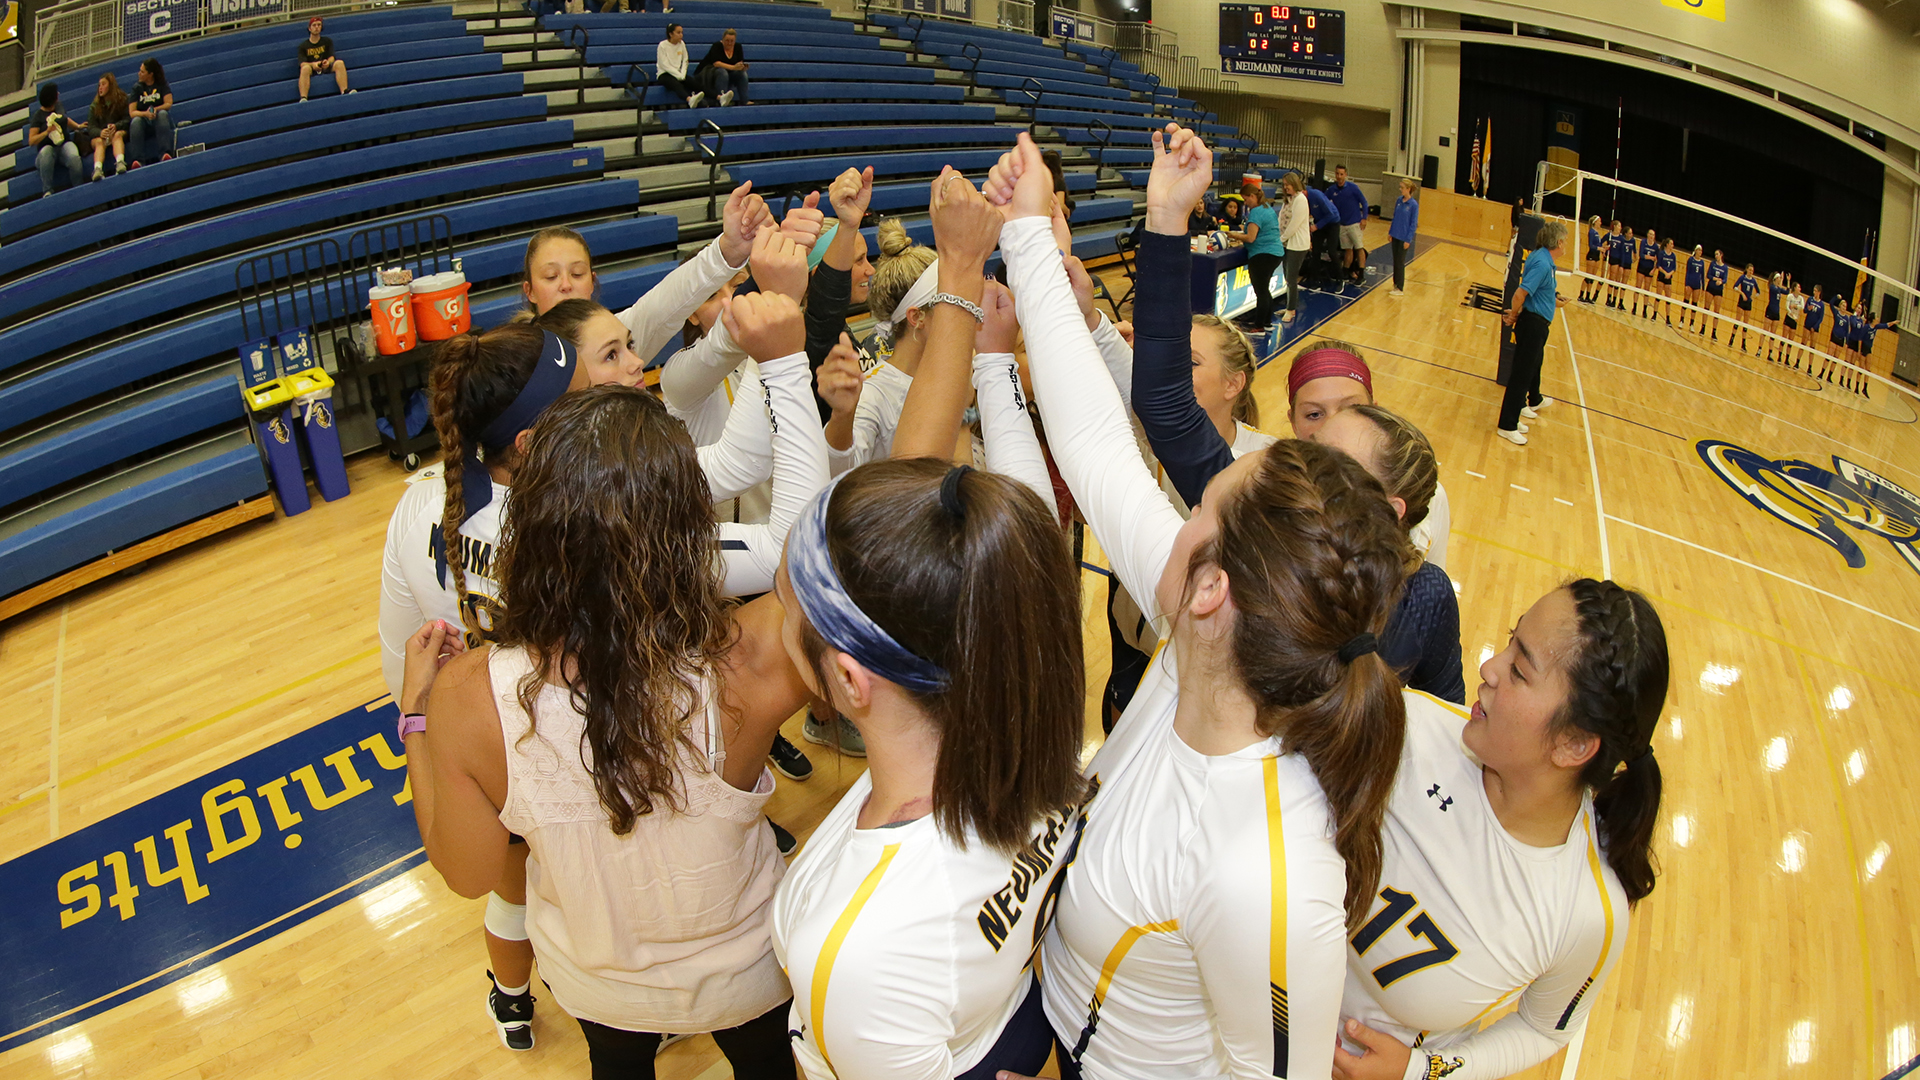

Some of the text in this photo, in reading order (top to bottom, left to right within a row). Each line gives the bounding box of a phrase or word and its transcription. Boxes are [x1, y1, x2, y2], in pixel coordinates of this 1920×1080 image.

[149, 10, 171, 34] C
[1254, 12, 1263, 25] 0
[1307, 15, 1316, 29] 0
[1292, 24, 1298, 33] 1
[1249, 38, 1269, 50] 0 2
[1292, 41, 1314, 54] 2 0
[1235, 61, 1282, 74] NEUMANN
[1282, 66, 1298, 75] HOME
[1306, 68, 1317, 76] THE
[1317, 70, 1342, 79] KNIGHTS
[390, 300, 405, 318] G
[446, 299, 459, 314] G
[255, 375, 267, 383] ONLY
[1350, 884, 1462, 991] 17
